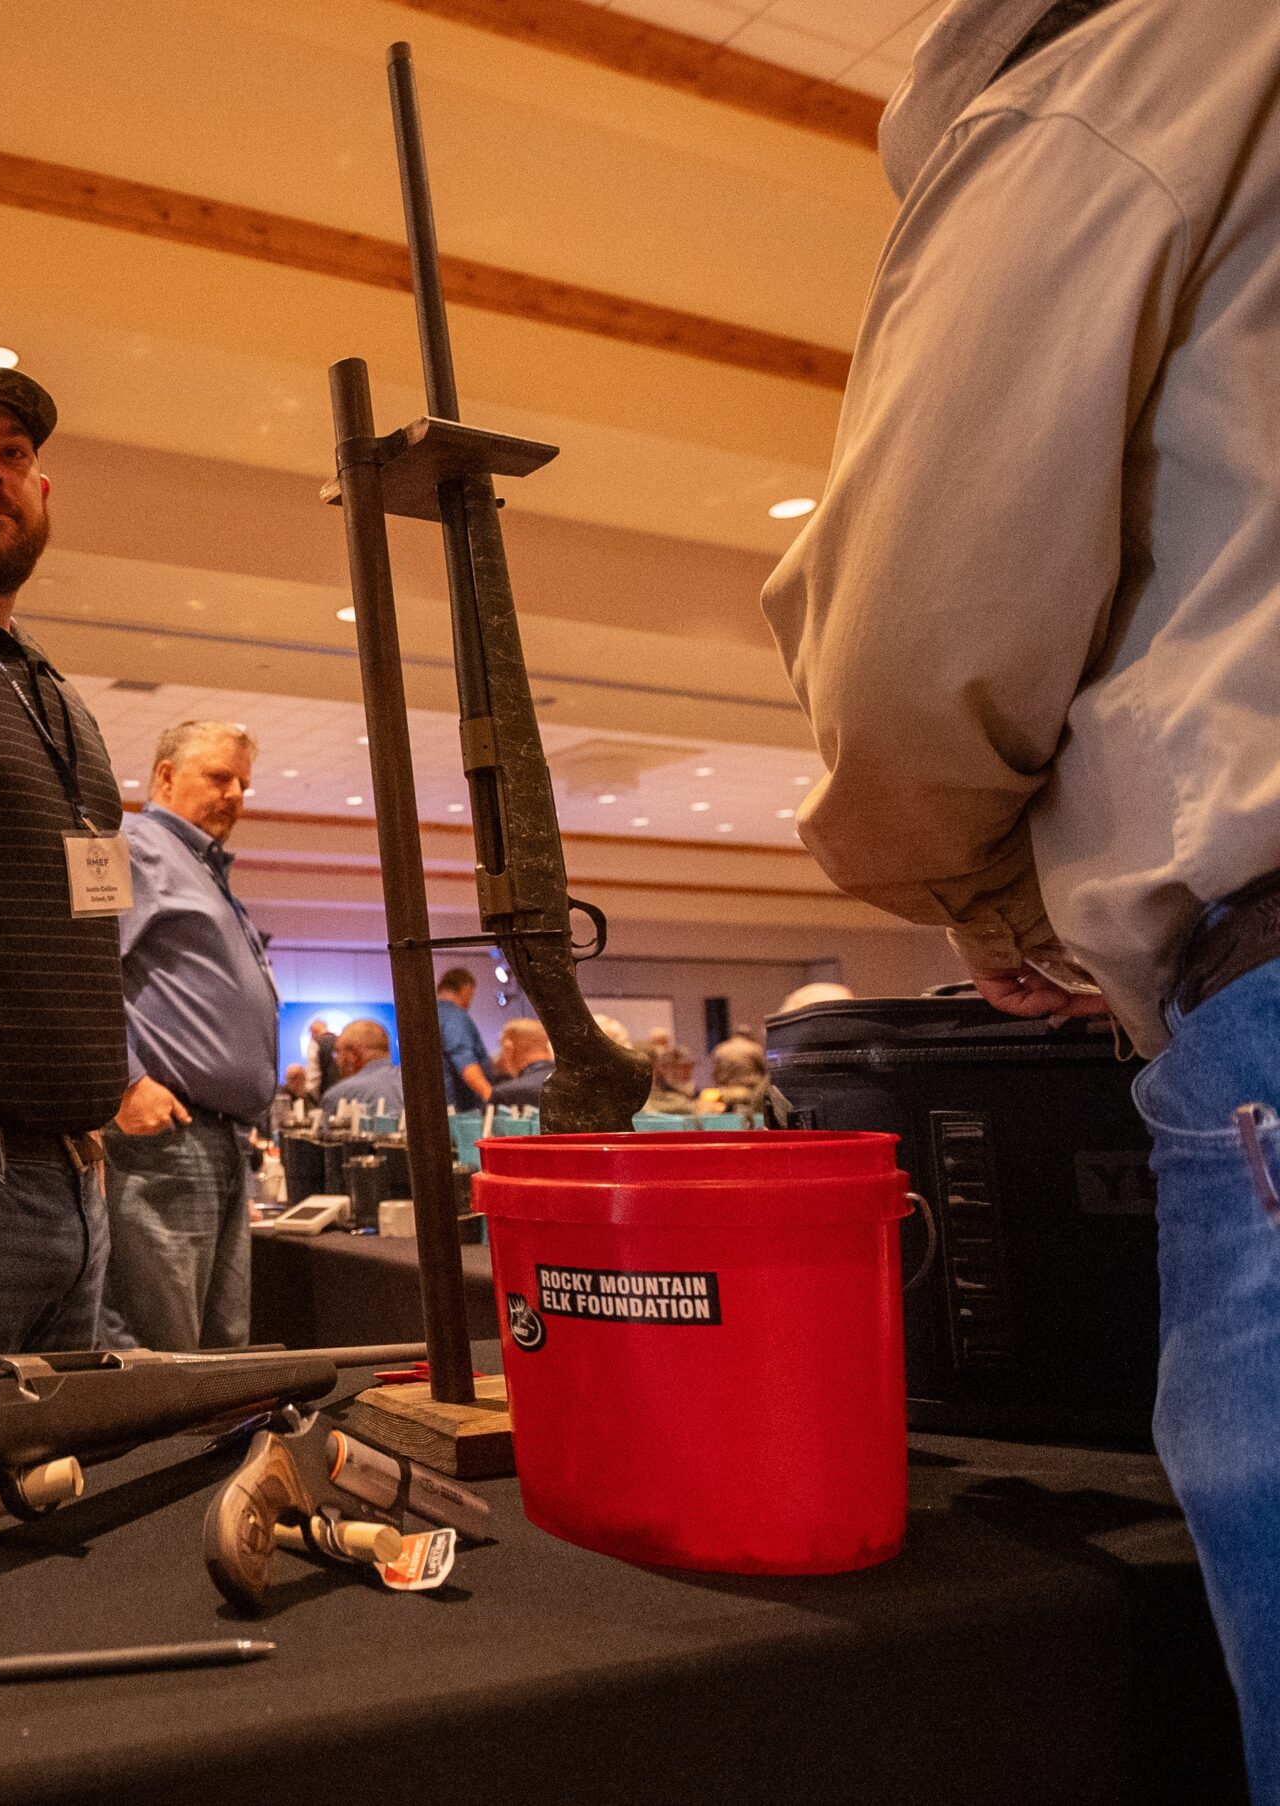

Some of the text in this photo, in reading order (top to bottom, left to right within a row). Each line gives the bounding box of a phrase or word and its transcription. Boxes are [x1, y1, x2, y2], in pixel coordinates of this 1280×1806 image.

[86, 858, 109, 866] RMEF
[540, 1270, 707, 1296] ROCKY MOUNTAIN
[542, 1290, 710, 1319] ELK FOUNDATION
